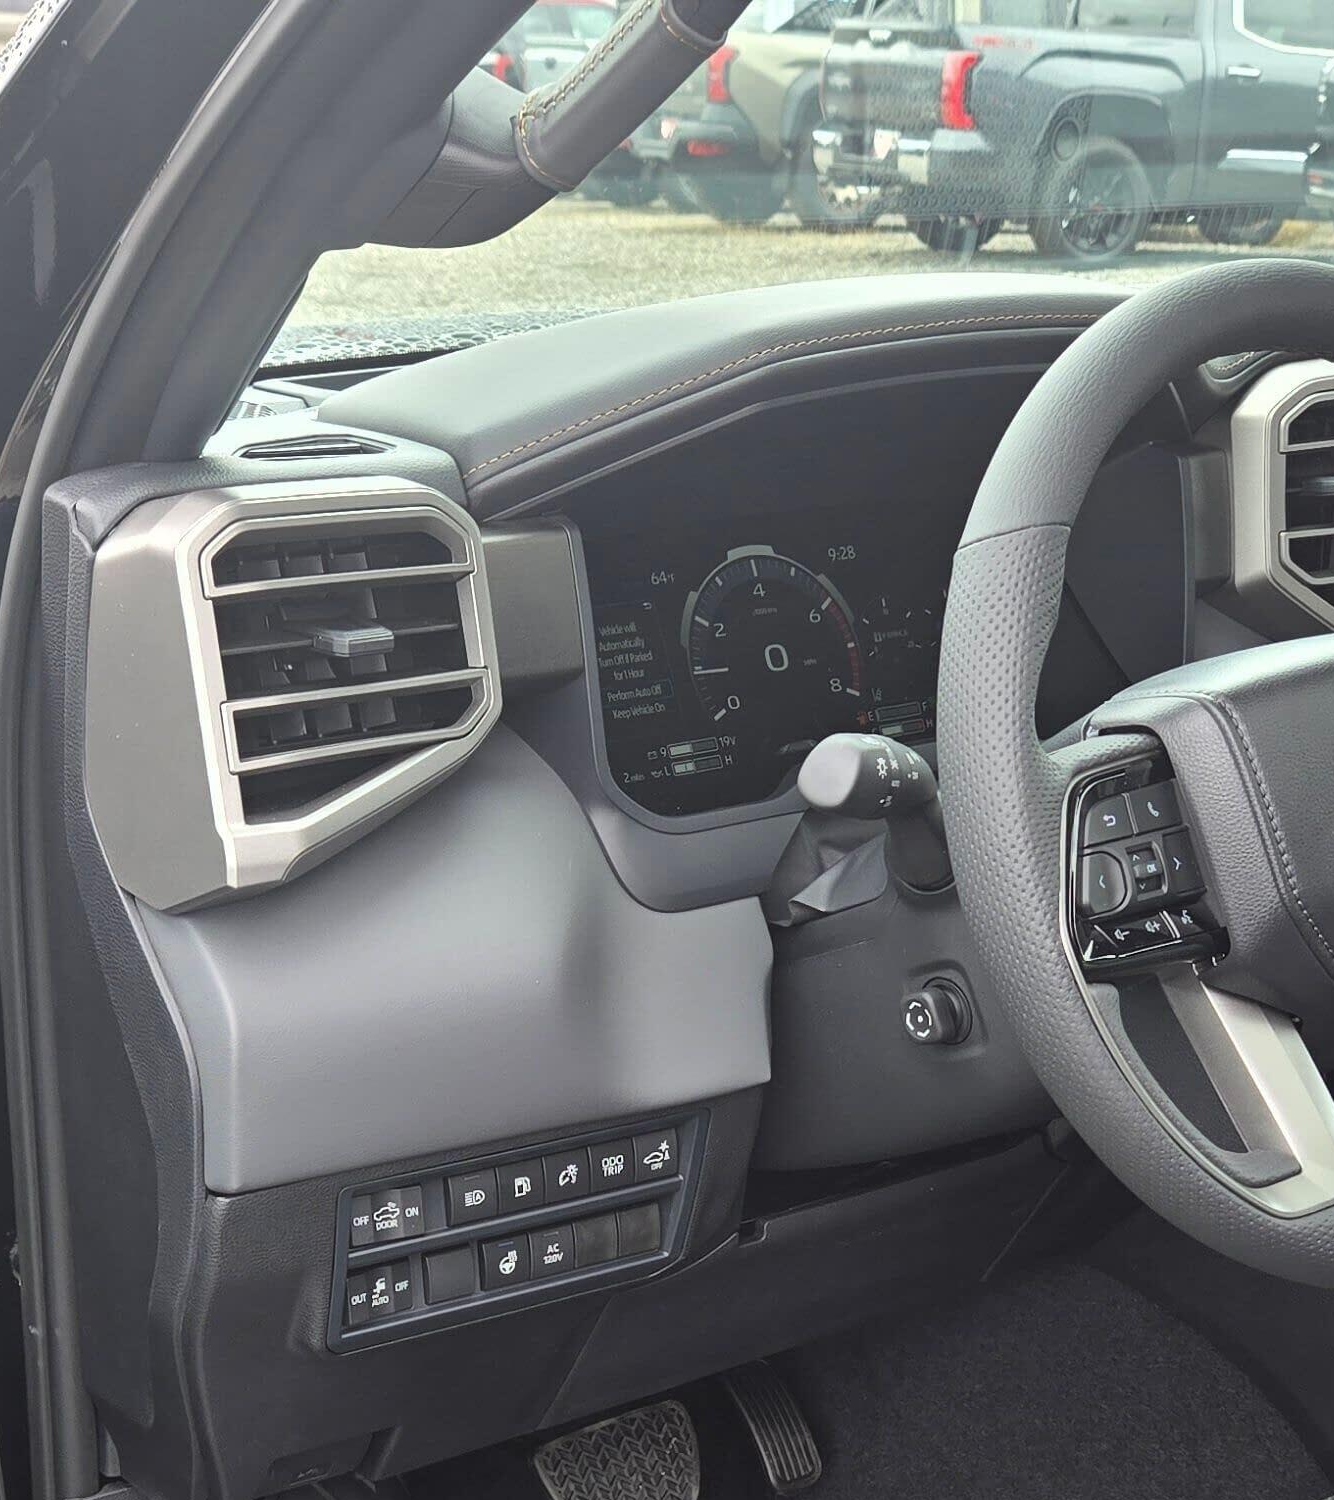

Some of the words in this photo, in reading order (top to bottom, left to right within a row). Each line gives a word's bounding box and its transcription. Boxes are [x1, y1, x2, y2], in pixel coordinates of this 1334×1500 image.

[828, 546, 857, 561] 9:28
[753, 583, 766, 597] 4
[809, 609, 821, 623] 6
[714, 623, 727, 637] 2
[598, 636, 645, 653] Automatically
[764, 644, 789, 672] 0
[829, 678, 842, 692] 8
[727, 695, 740, 710] 0
[601, 1154, 624, 1168] ODO
[651, 1162, 663, 1171] OFF
[602, 1164, 624, 1177] TRIP
[405, 1206, 419, 1218] ON
[353, 1215, 369, 1227] OFF
[375, 1219, 399, 1231] DOOR
[547, 1243, 559, 1254] AC
[543, 1252, 564, 1265] 120V
[394, 1280, 409, 1292] OFF
[351, 1293, 367, 1305] OUT
[372, 1295, 389, 1307] AUTO
